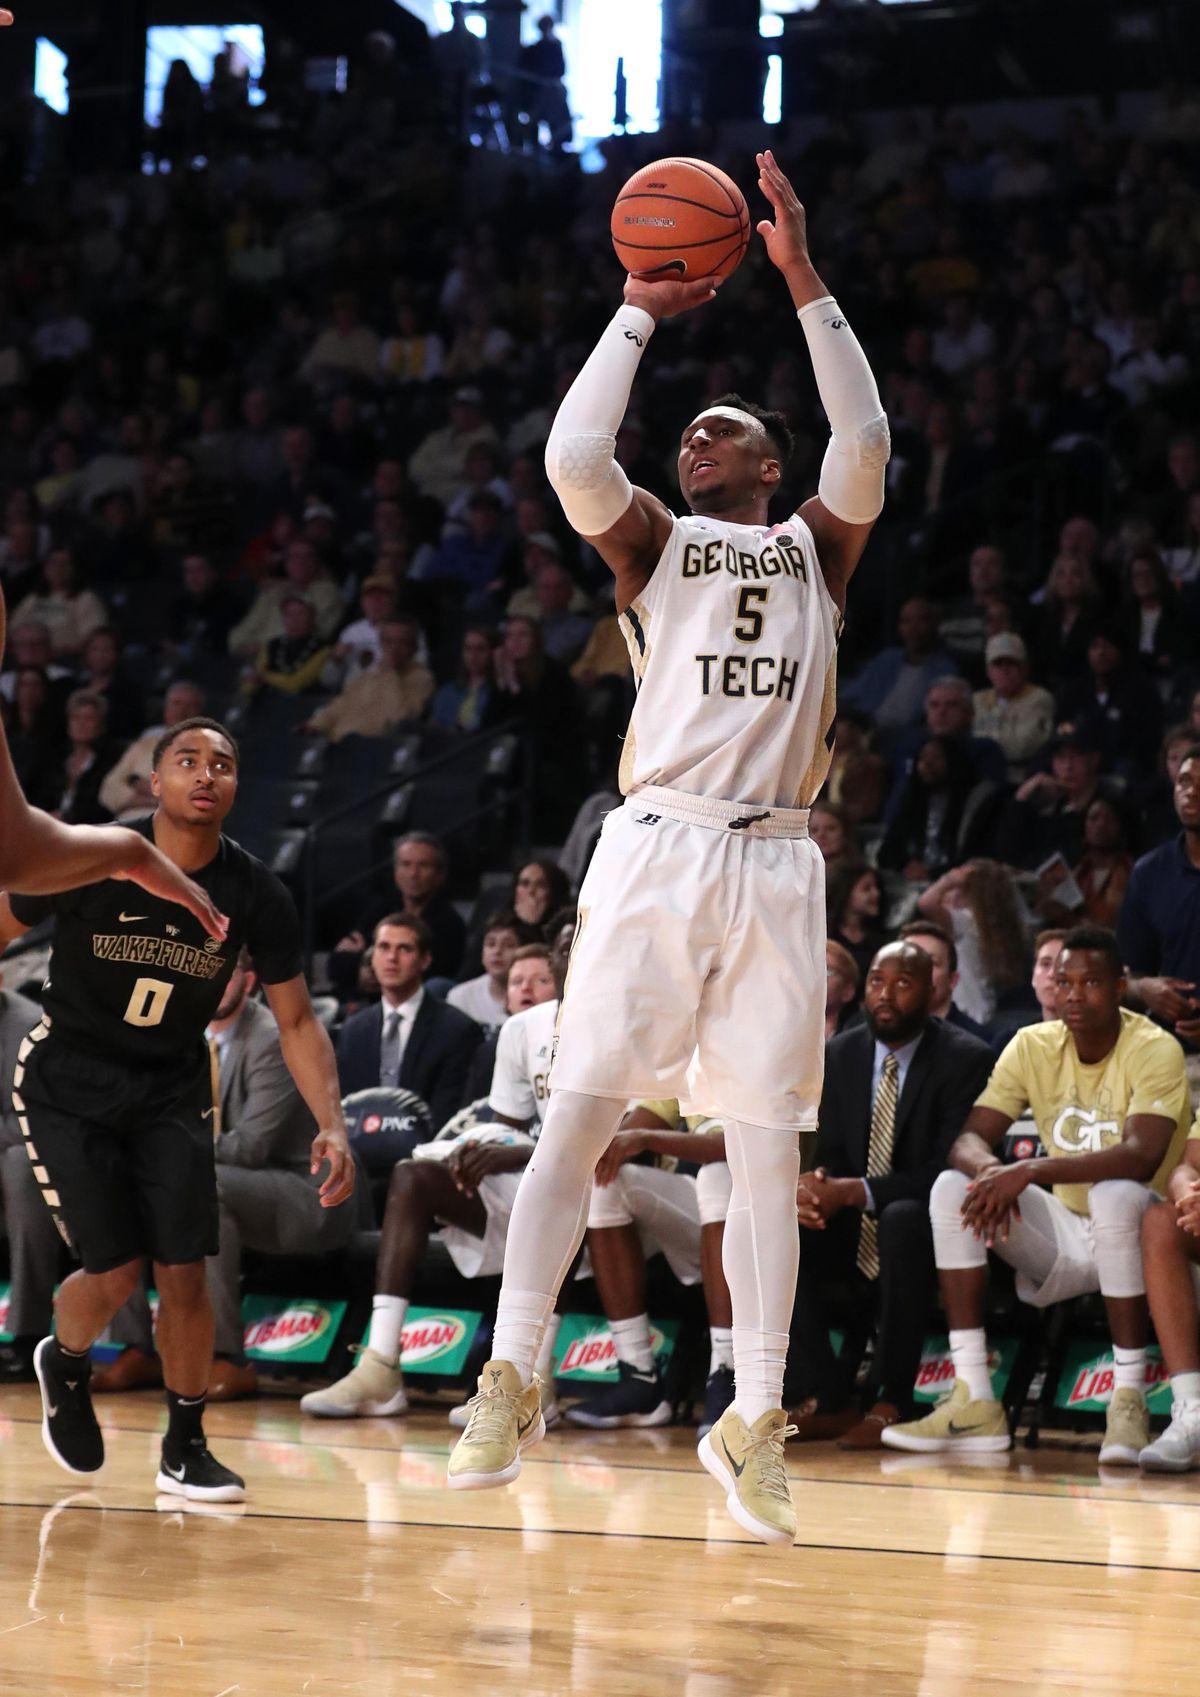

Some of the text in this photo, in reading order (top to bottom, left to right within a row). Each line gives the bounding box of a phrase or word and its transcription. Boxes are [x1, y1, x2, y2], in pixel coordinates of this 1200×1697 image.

[682, 539, 808, 584] GEORGIA
[734, 584, 769, 643] 5
[695, 654, 800, 702] TECH
[92, 934, 227, 980] WAKE FOREST
[123, 977, 174, 1027] 0
[380, 1116, 417, 1132] PNC
